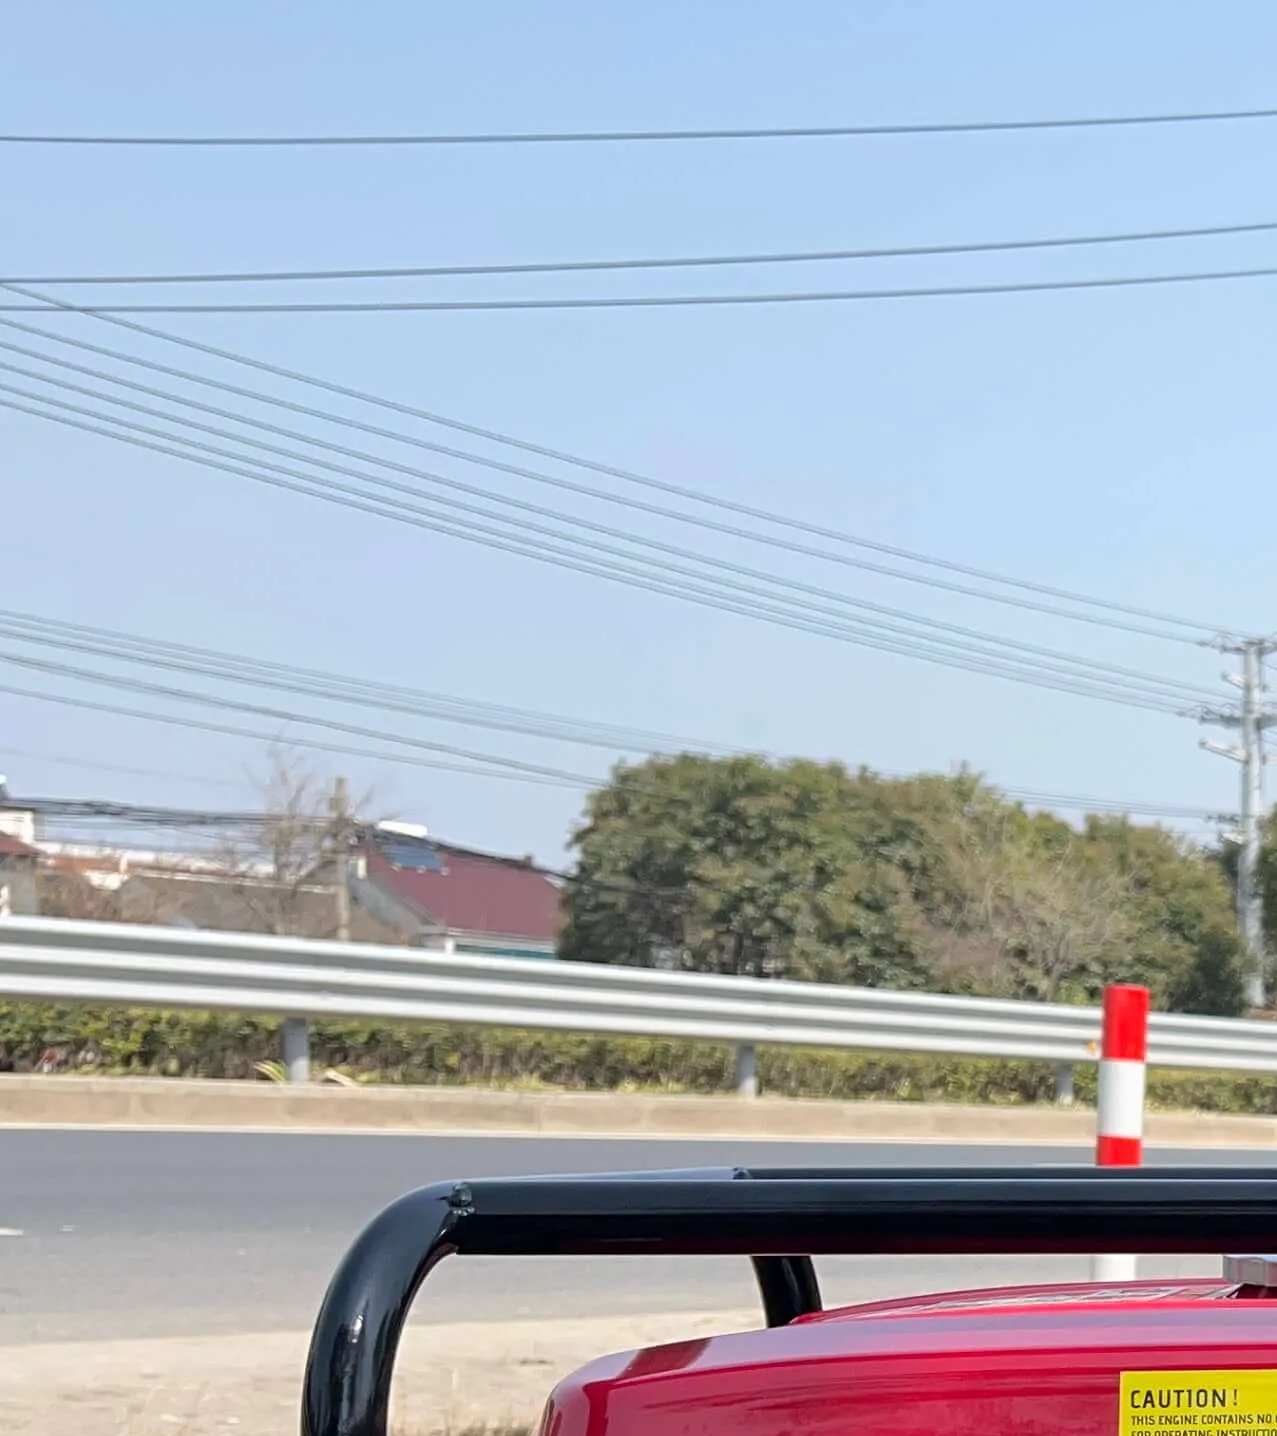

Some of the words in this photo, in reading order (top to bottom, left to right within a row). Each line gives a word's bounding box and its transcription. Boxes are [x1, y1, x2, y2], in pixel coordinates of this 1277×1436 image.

[1131, 1415, 1156, 1426] THIS
[1158, 1415, 1199, 1425] ENGINE
[1201, 1414, 1254, 1425] CONTAINS
[1257, 1414, 1272, 1424] NO
